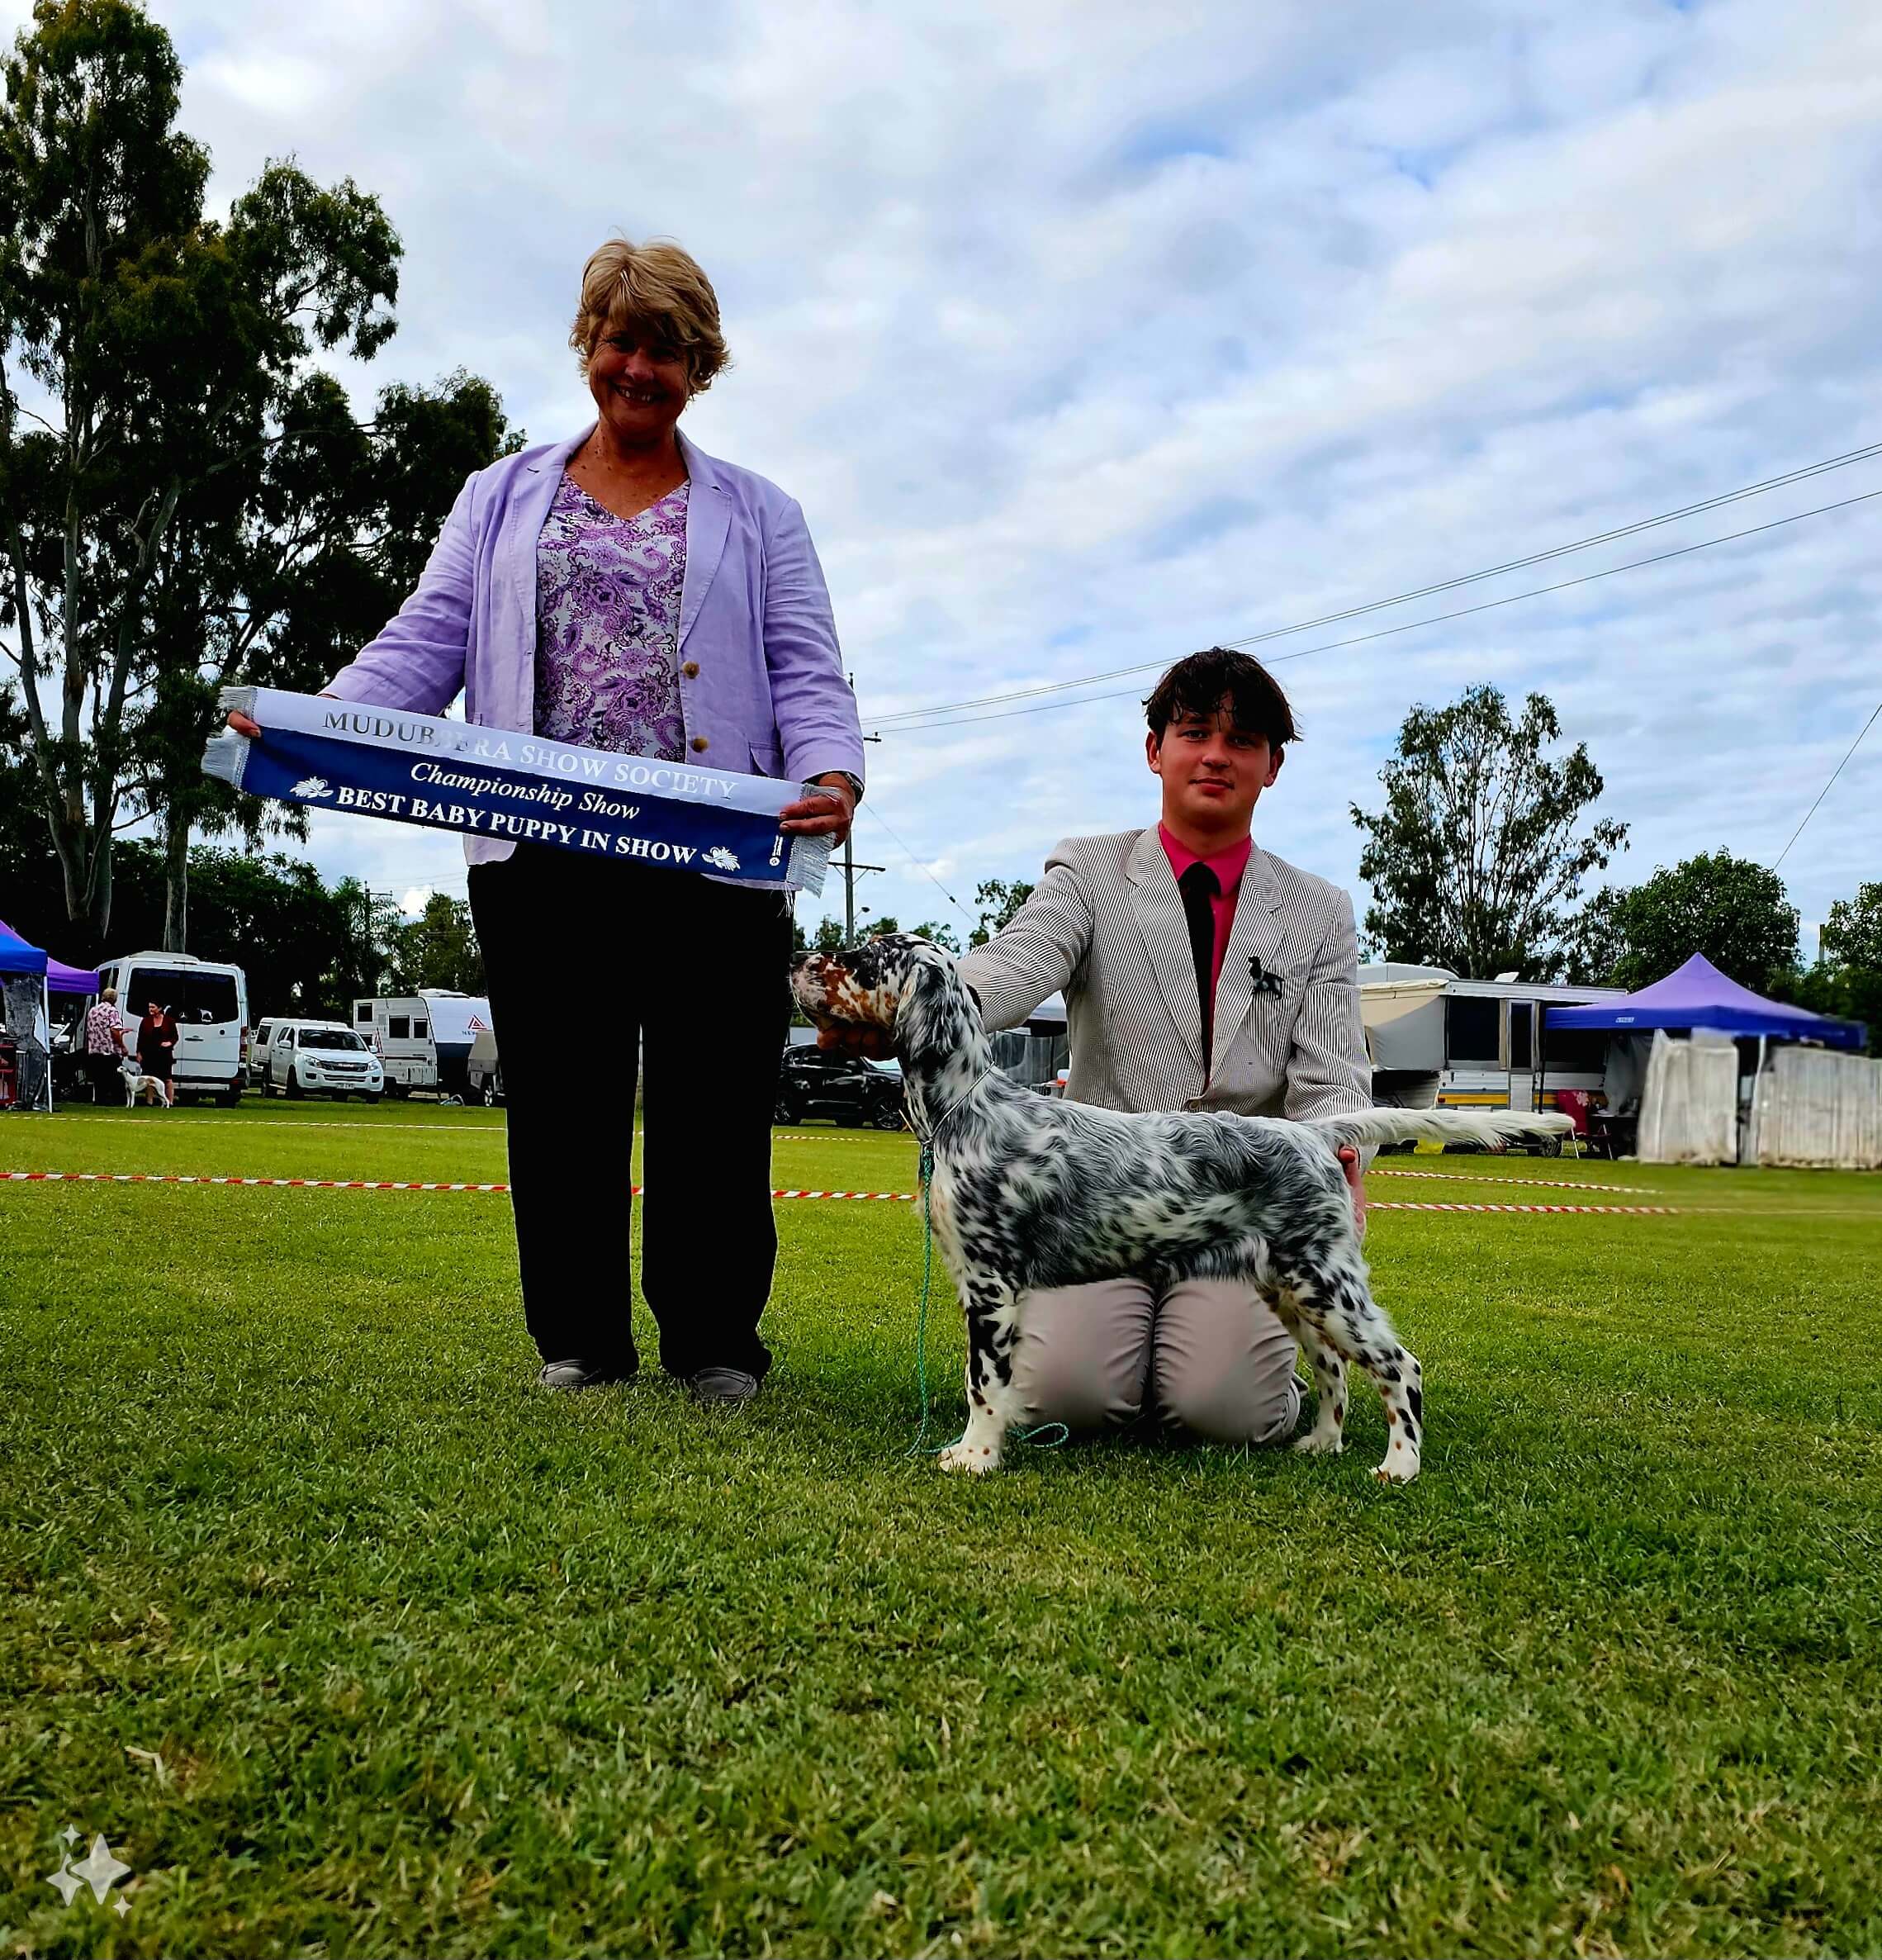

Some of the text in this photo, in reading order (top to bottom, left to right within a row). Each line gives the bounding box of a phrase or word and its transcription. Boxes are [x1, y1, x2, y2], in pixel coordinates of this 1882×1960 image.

[410, 762, 640, 819] Championship Show
[520, 745, 608, 779] SHOW
[614, 763, 739, 800] SOCIETY
[336, 786, 697, 864] BEST BABY PUPPY IN SHOW
